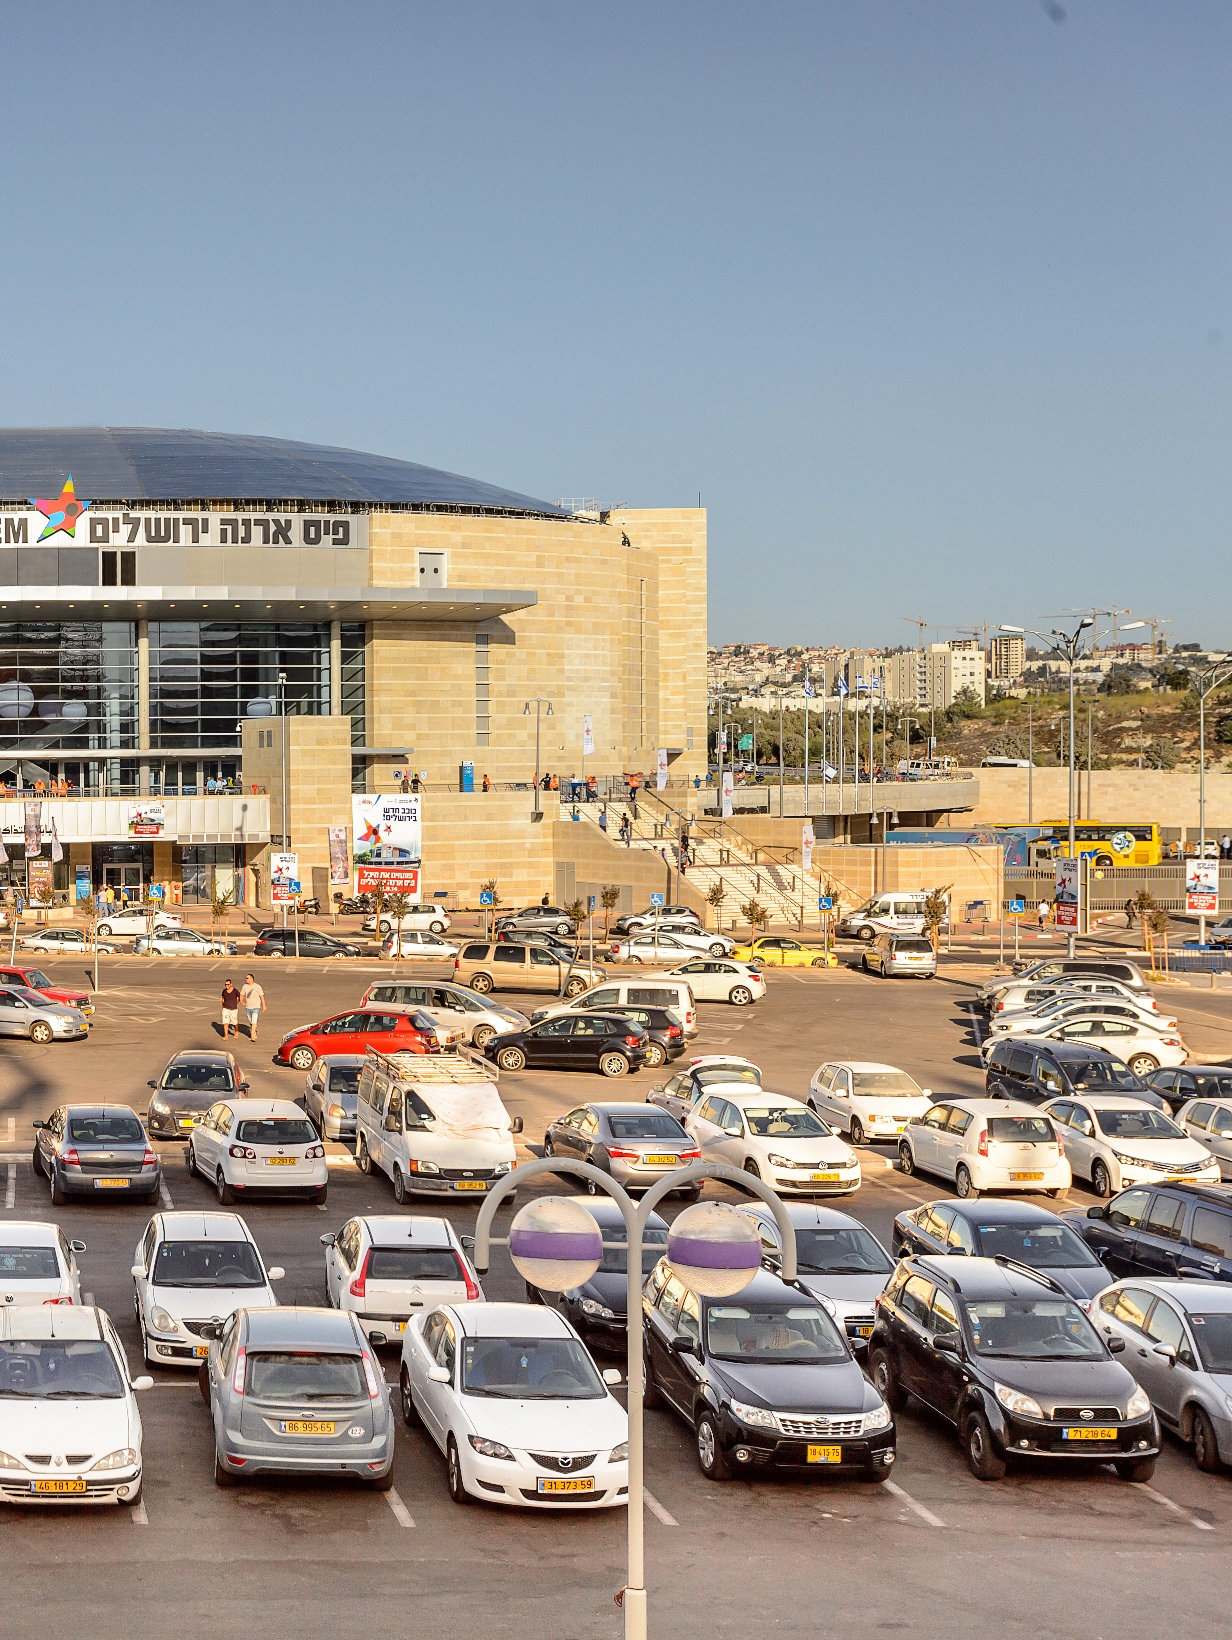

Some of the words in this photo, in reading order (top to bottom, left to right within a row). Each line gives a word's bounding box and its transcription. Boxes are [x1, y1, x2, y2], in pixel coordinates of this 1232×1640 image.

[88, 514, 210, 545] ירושלים
[219, 517, 293, 546] ארנה
[303, 518, 350, 546] פיס
